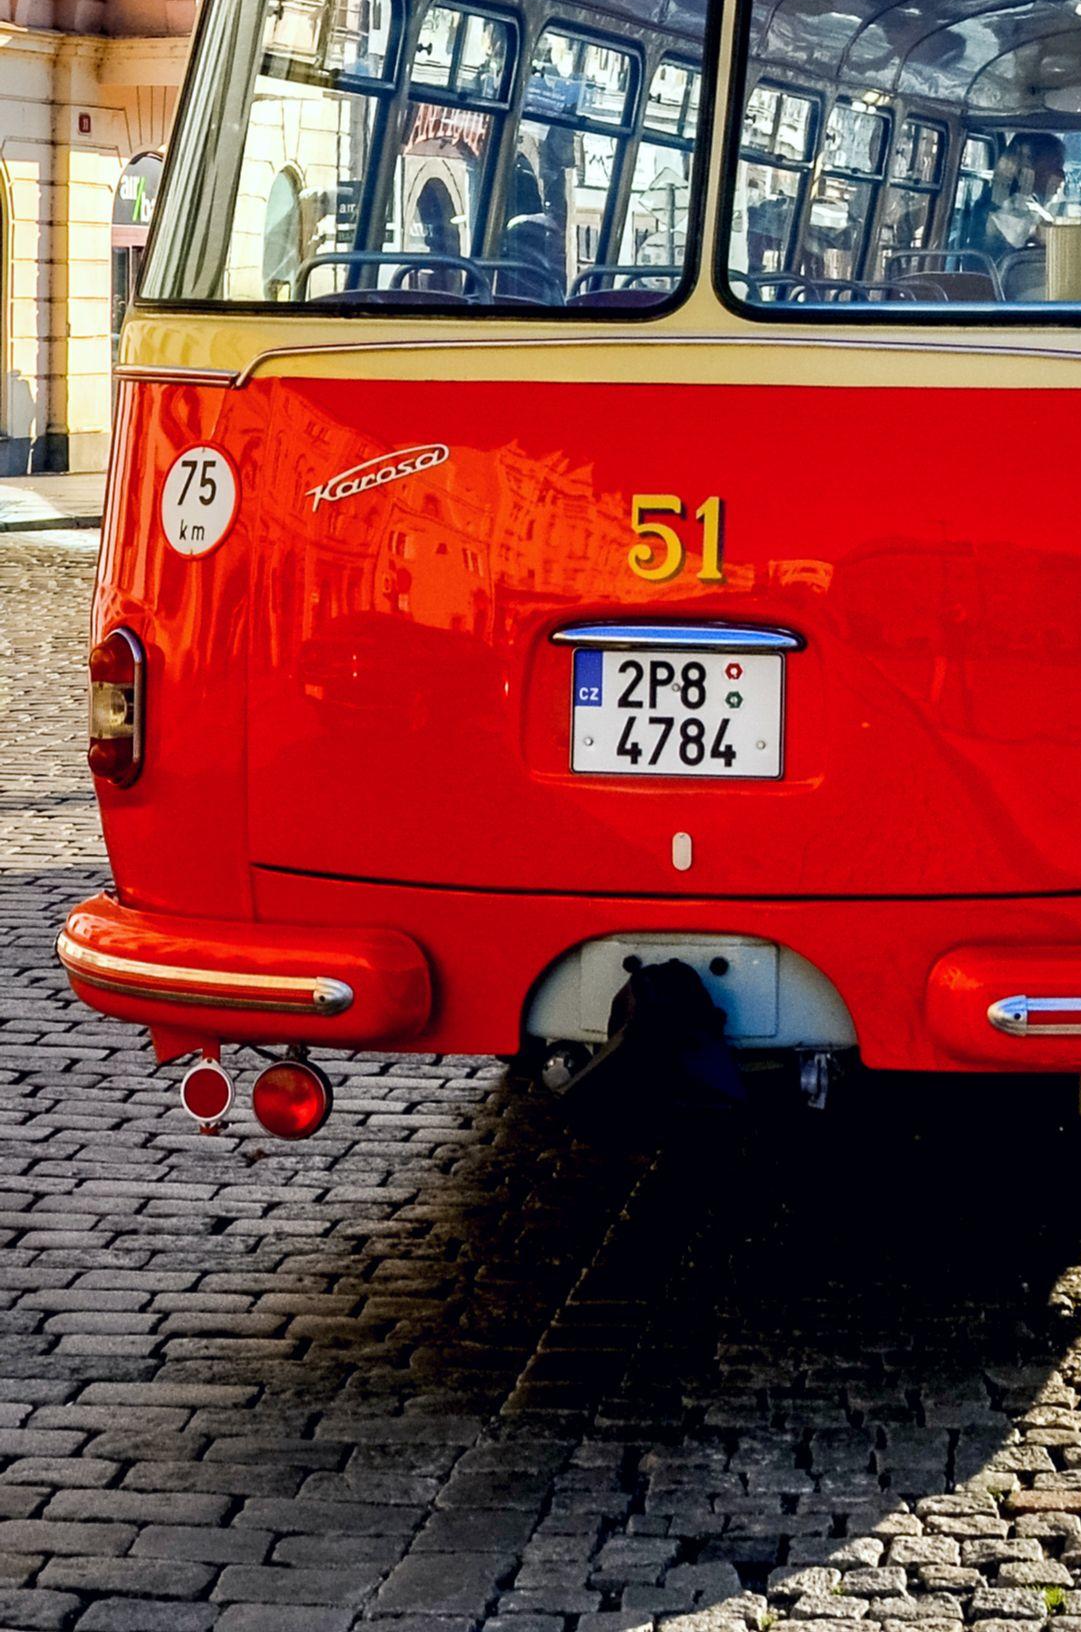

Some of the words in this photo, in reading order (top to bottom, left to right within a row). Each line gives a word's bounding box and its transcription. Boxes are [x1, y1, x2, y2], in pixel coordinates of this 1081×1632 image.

[177, 460, 217, 506] 75
[305, 443, 450, 512] Karosa
[179, 520, 205, 541] km
[628, 494, 723, 581] 51
[579, 687, 599, 701] CZ
[617, 660, 706, 709] 2P8
[616, 716, 737, 767] 4784
